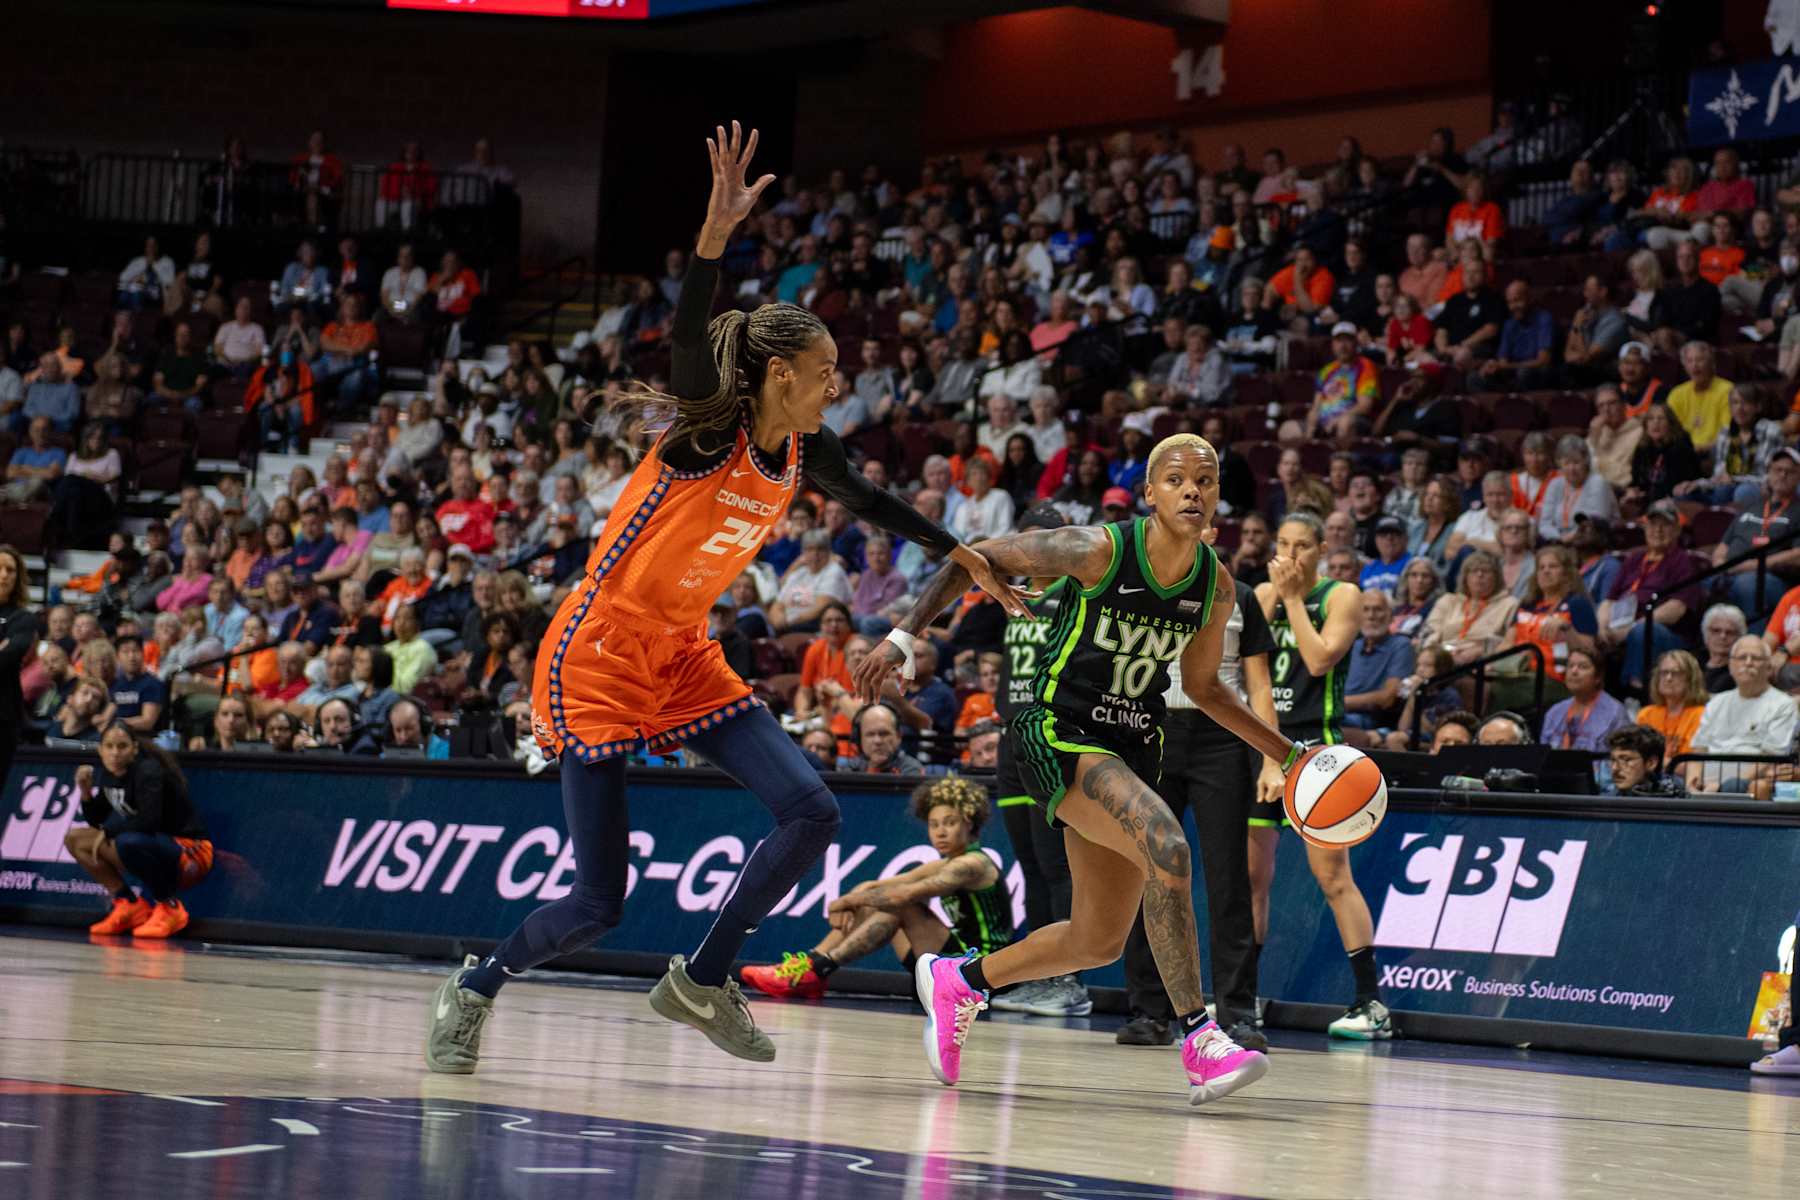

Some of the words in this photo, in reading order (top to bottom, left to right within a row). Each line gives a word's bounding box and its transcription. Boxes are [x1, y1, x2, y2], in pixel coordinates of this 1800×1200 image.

[1170, 46, 1227, 99] 14
[700, 516, 771, 557] 24
[1004, 622, 1053, 645] LYNX
[1093, 614, 1195, 662] LYNX
[1009, 645, 1036, 677] 12
[1108, 654, 1158, 699] 10
[1275, 651, 1291, 683] 9
[1091, 705, 1152, 729] CLINIC
[323, 818, 505, 894] VISIT
[1378, 964, 1456, 992] xerox
[1464, 976, 1526, 998] Business
[1528, 980, 1597, 1003] Solutions
[1599, 985, 1675, 1013] Company
